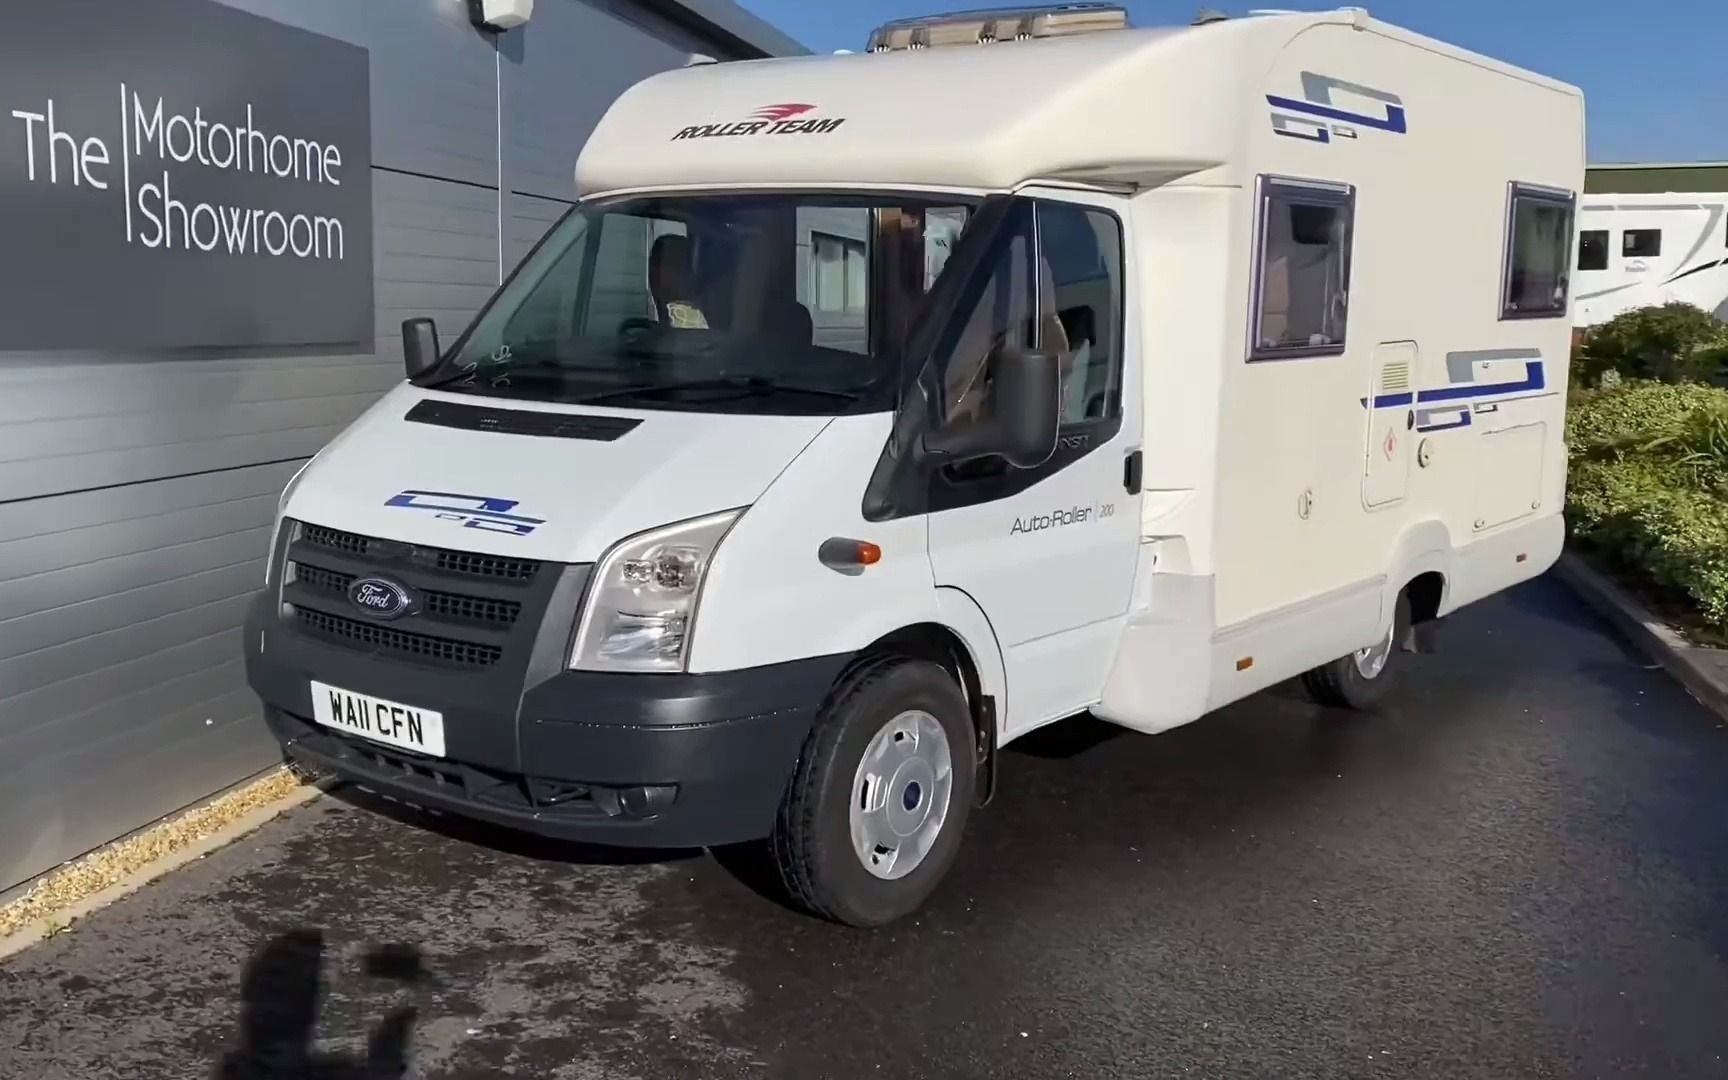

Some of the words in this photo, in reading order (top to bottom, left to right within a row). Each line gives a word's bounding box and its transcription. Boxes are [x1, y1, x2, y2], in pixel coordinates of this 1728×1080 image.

[12, 98, 110, 190] The
[133, 91, 342, 186] Motorhome
[670, 121, 769, 141] ROLLER
[765, 118, 846, 135] TEAM
[138, 170, 343, 260] Showroom
[357, 583, 391, 609] Ford
[329, 690, 370, 731] WA11
[376, 703, 424, 745] CFN
